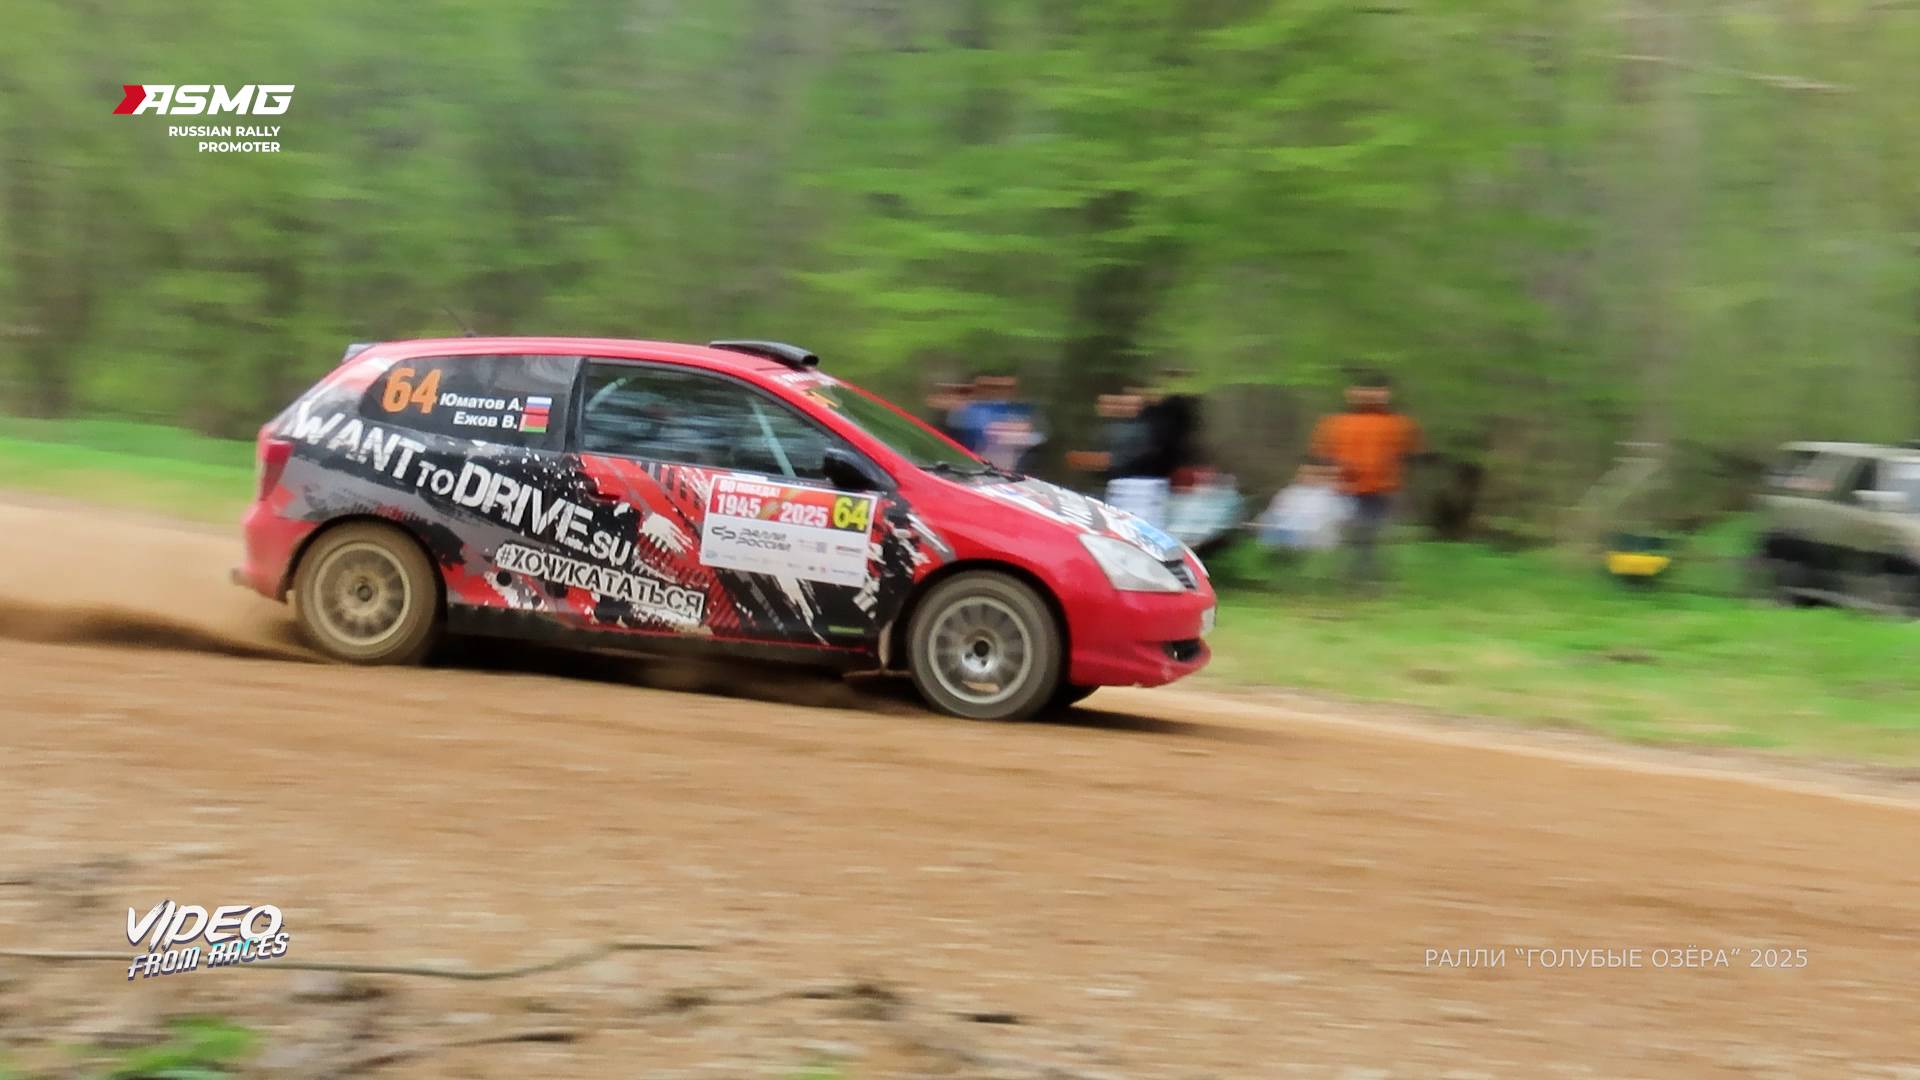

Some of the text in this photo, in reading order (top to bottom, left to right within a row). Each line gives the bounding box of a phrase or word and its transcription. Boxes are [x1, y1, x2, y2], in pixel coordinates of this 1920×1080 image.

[382, 367, 442, 415] 64
[439, 392, 524, 412] Юматов А.
[452, 411, 518, 430] Ежов В.
[716, 493, 870, 531] 1945 2025 64
[498, 546, 702, 616] #ХОЧУКАТАТЬСЯ
